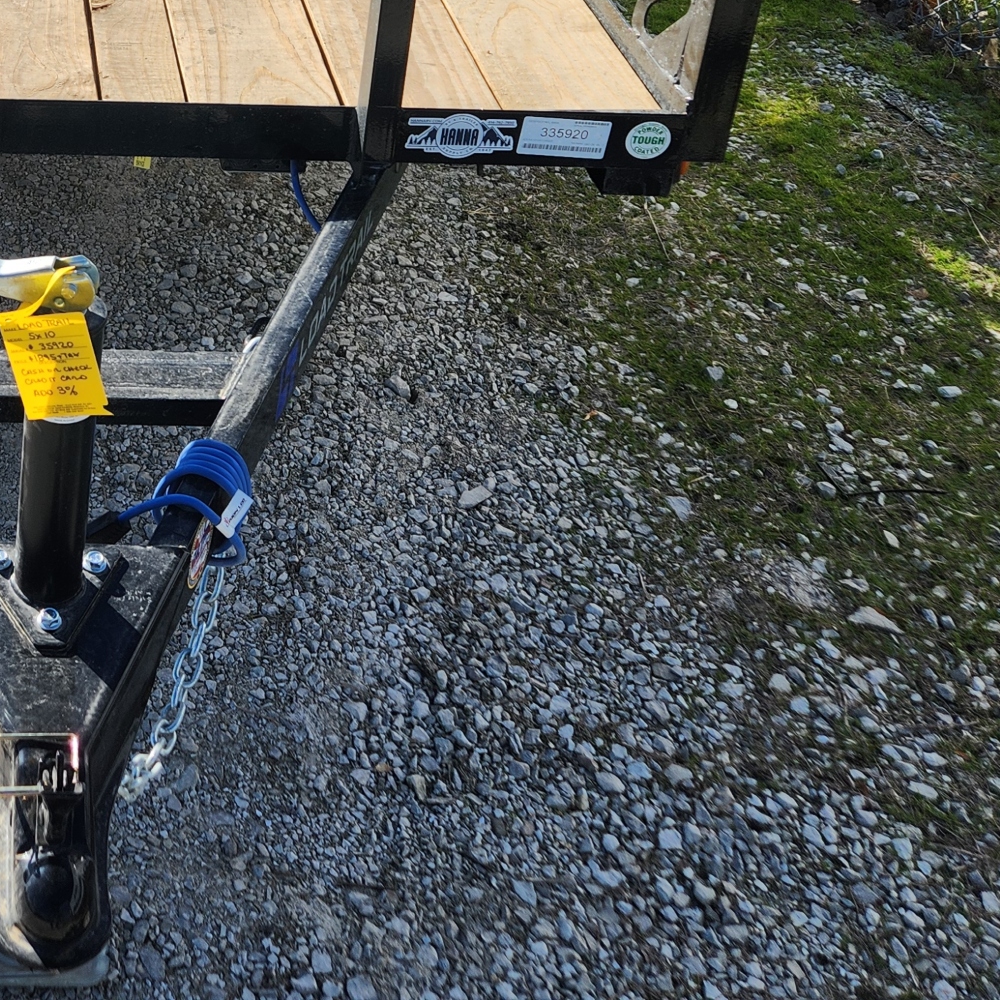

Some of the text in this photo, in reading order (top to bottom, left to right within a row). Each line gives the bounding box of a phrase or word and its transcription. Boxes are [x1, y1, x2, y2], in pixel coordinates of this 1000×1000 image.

[540, 126, 589, 140] 335920
[637, 126, 664, 135] POWDER
[440, 128, 480, 146] HANNA
[632, 135, 666, 145] TOUGH
[633, 146, 660, 155] COATED
[299, 210, 374, 367] LOAD TRAIL
[43, 318, 74, 327] TRAIL
[39, 341, 74, 350] 35920
[21, 368, 44, 376] CASH
[63, 364, 92, 372] CHECK
[57, 385, 78, 396] 3%
